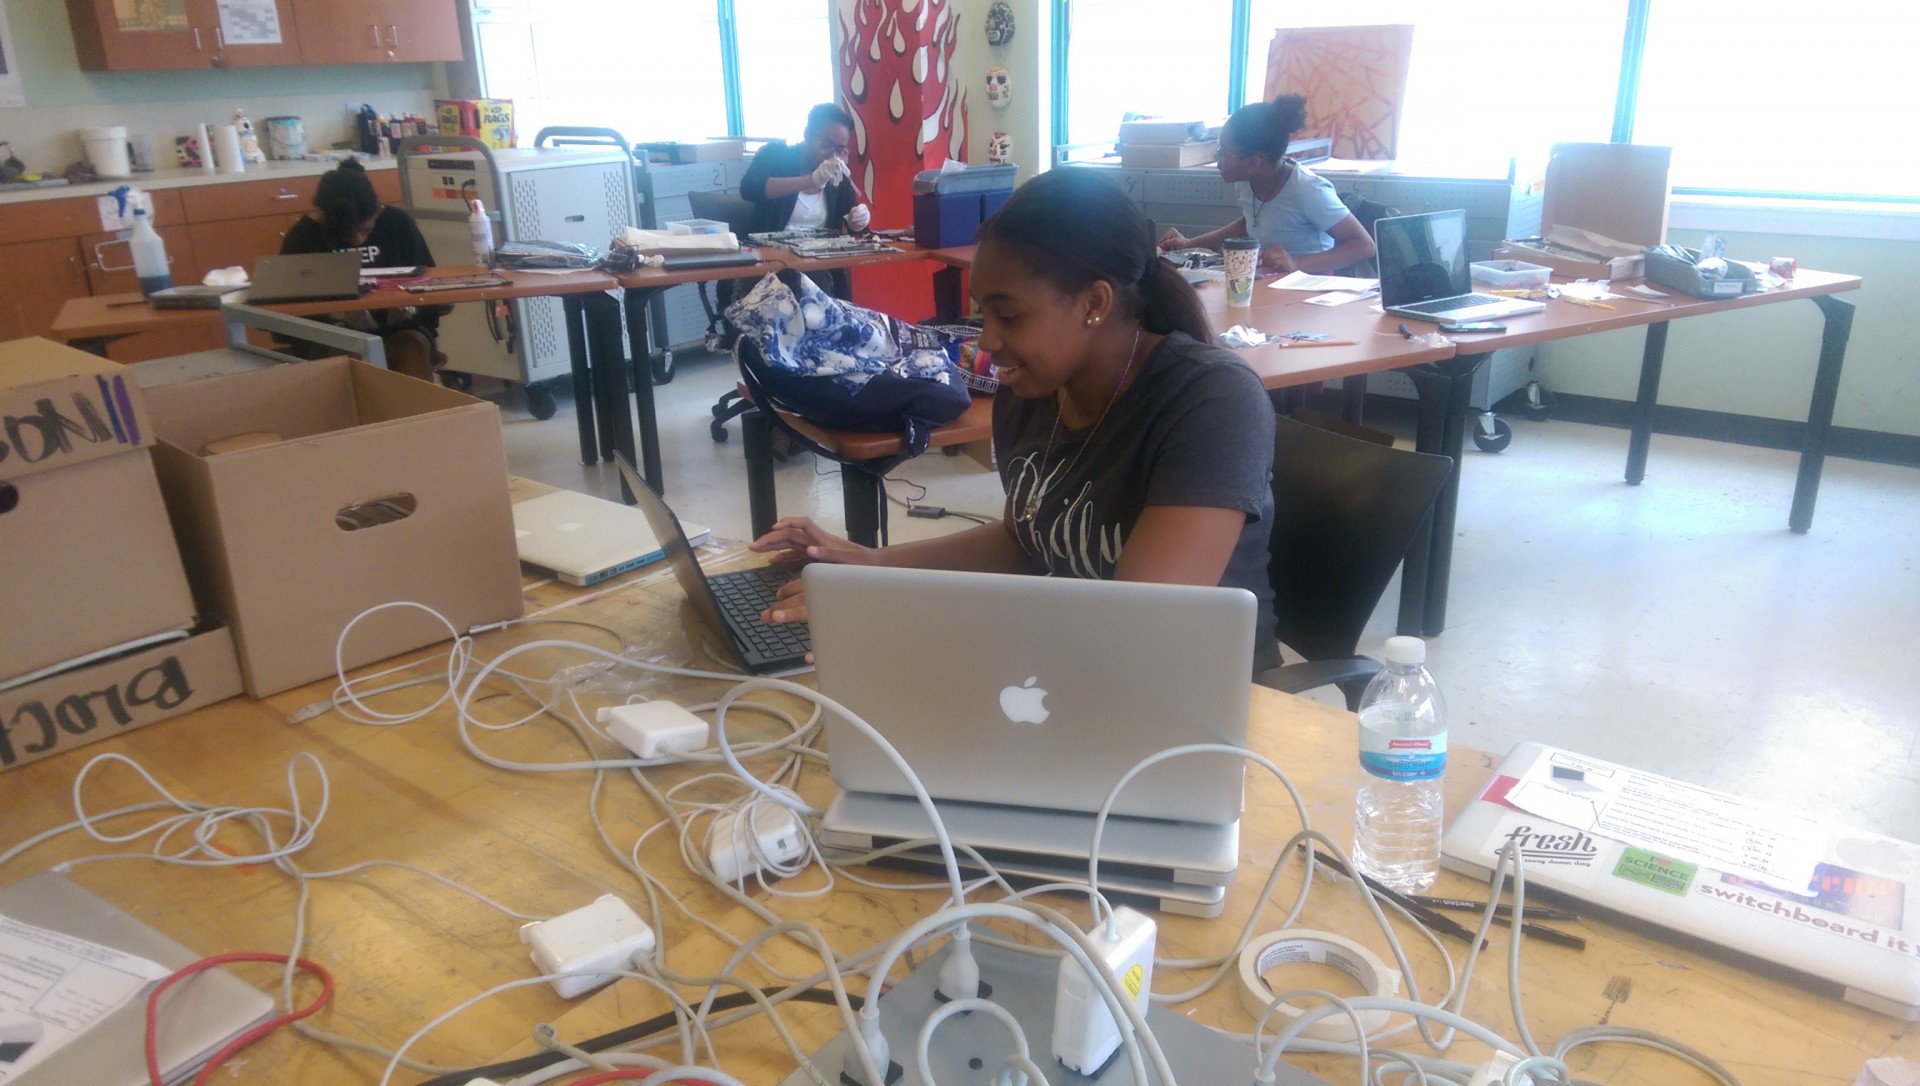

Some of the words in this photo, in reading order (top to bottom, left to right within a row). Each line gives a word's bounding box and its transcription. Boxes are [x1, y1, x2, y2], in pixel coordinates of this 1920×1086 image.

[483, 112, 511, 124] RAGS
[332, 245, 380, 263] EP
[1504, 825, 1597, 853] fresh
[1624, 856, 1690, 880] SCIENCE
[1700, 884, 1880, 943] switchboard
[1886, 935, 1909, 953] it
